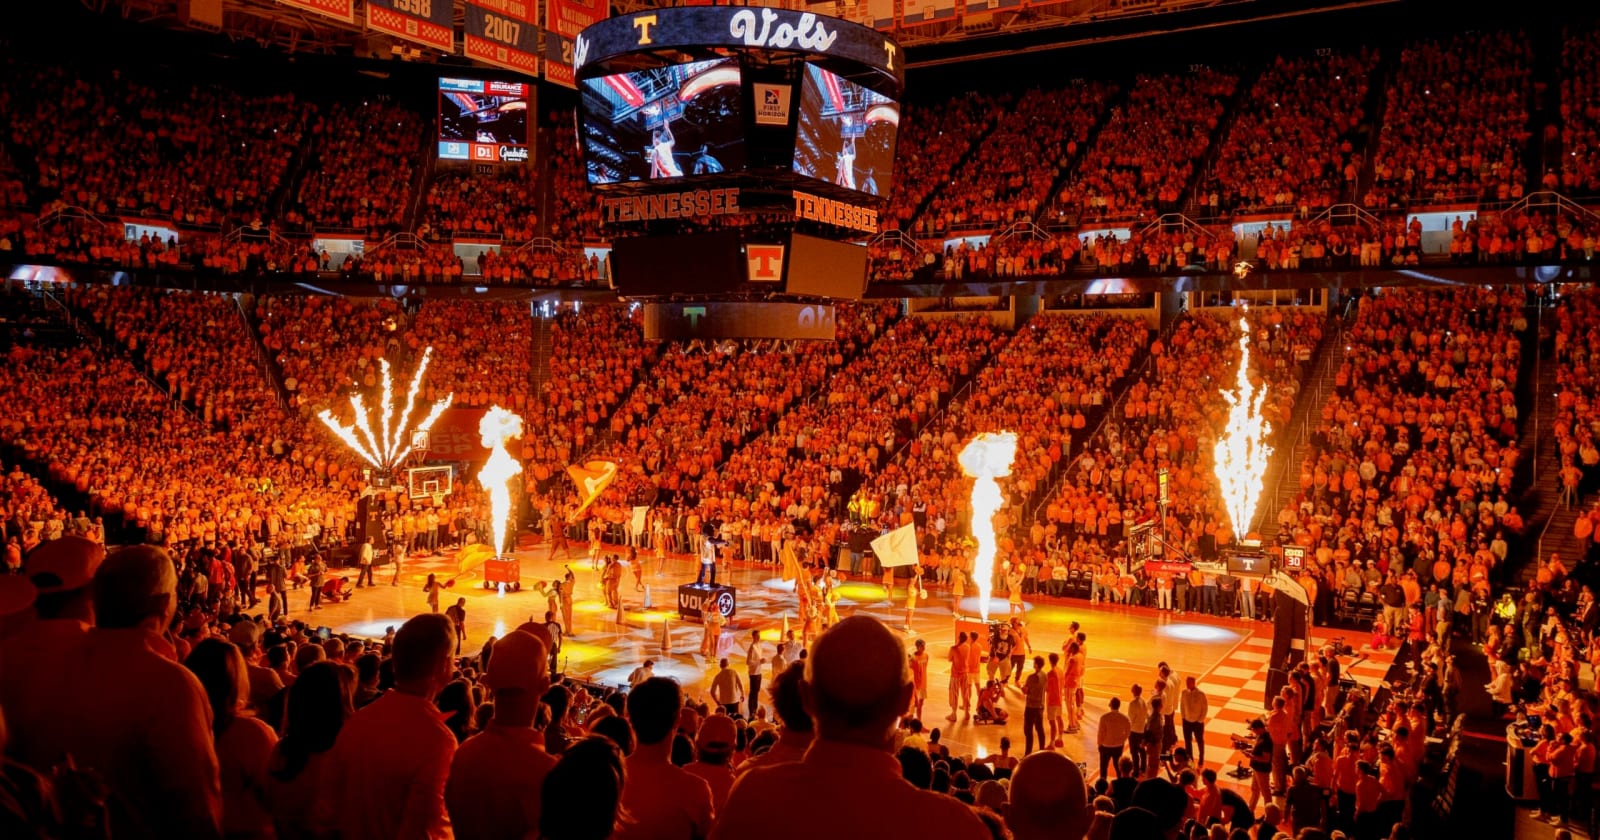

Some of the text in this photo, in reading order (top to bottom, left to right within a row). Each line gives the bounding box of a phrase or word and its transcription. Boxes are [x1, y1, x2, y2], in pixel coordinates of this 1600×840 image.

[484, 13, 520, 46] 2007
[633, 14, 657, 46] T
[730, 8, 837, 52] Vols
[884, 40, 896, 71] T
[477, 146, 492, 157] D1
[604, 187, 740, 223] TENNESSEE
[792, 189, 878, 234] TENNESSEE
[748, 247, 782, 278] T
[1242, 559, 1255, 571] T
[1288, 556, 1301, 567] 30
